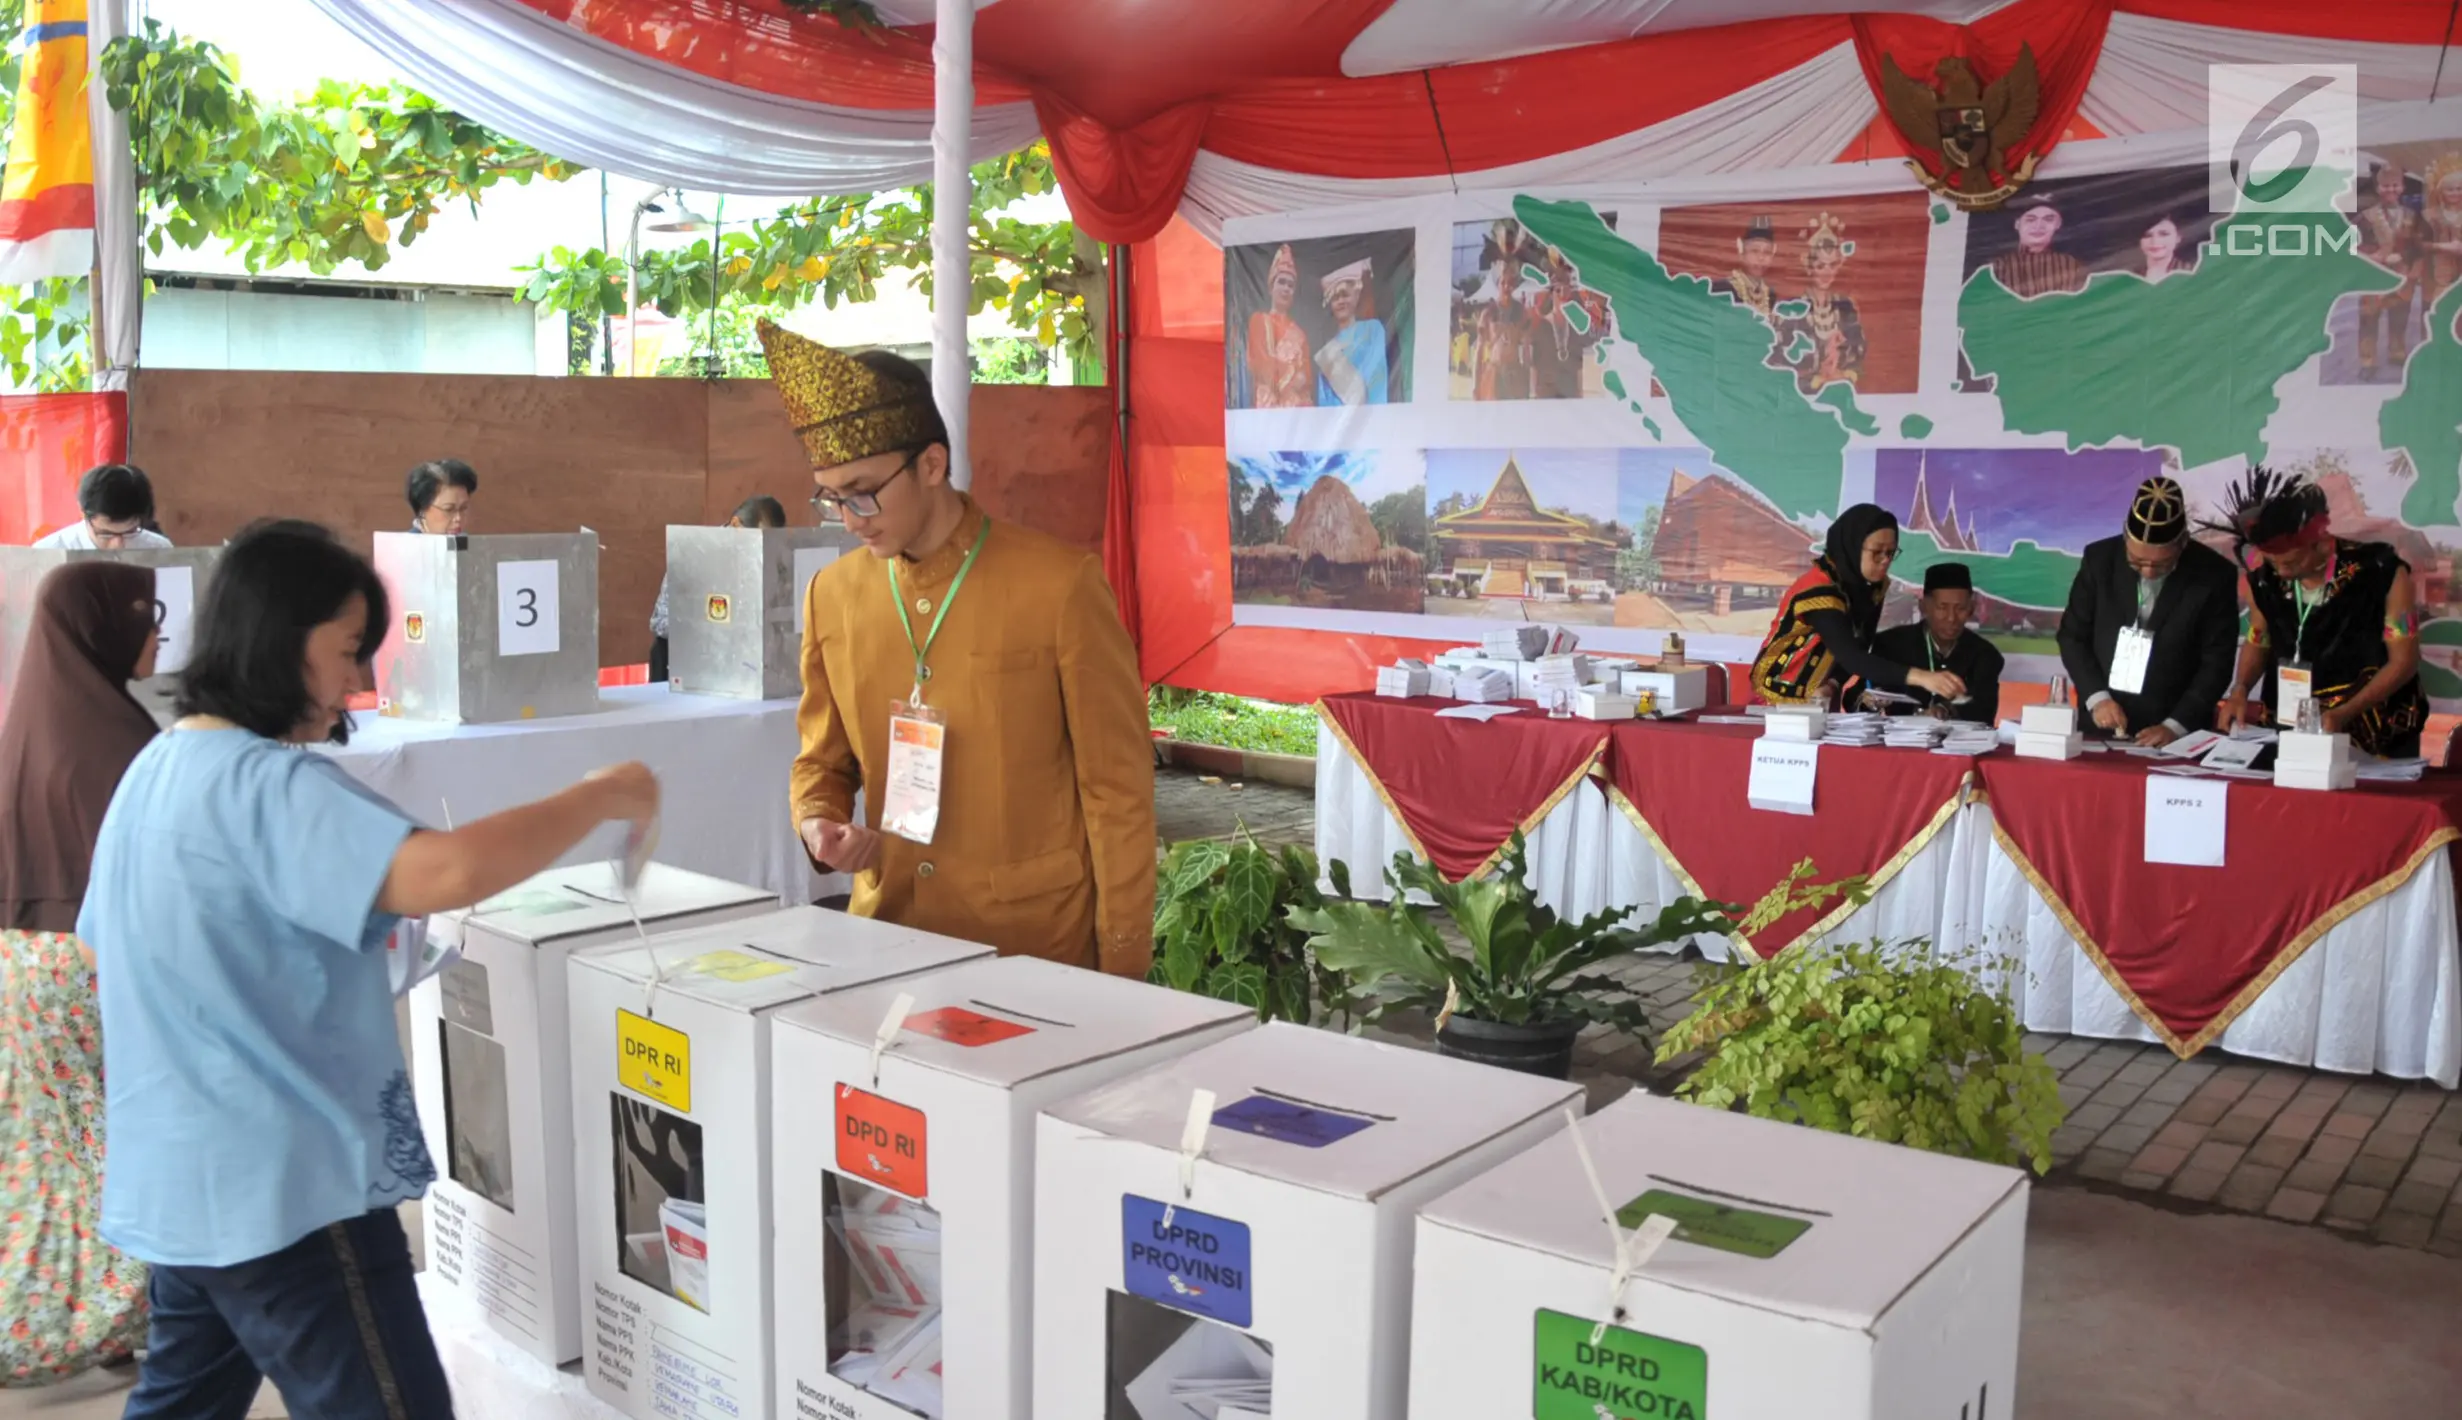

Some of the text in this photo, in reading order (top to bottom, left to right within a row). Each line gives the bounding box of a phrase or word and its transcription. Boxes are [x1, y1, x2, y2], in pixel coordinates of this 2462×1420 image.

[516, 588, 538, 627] 3
[1757, 756, 1809, 767] KETUA KPPS
[2166, 798, 2203, 808] KPPS 2
[625, 1036, 681, 1076] DPR RI
[846, 1114, 915, 1159] DPD RI
[1153, 1219, 1219, 1254] DPRD
[1131, 1241, 1243, 1290] PROVINSI
[1576, 1341, 1660, 1382] DPRD
[797, 1379, 856, 1419] Nomor Kotak
[1541, 1363, 1696, 1420] KAB/KOTA
